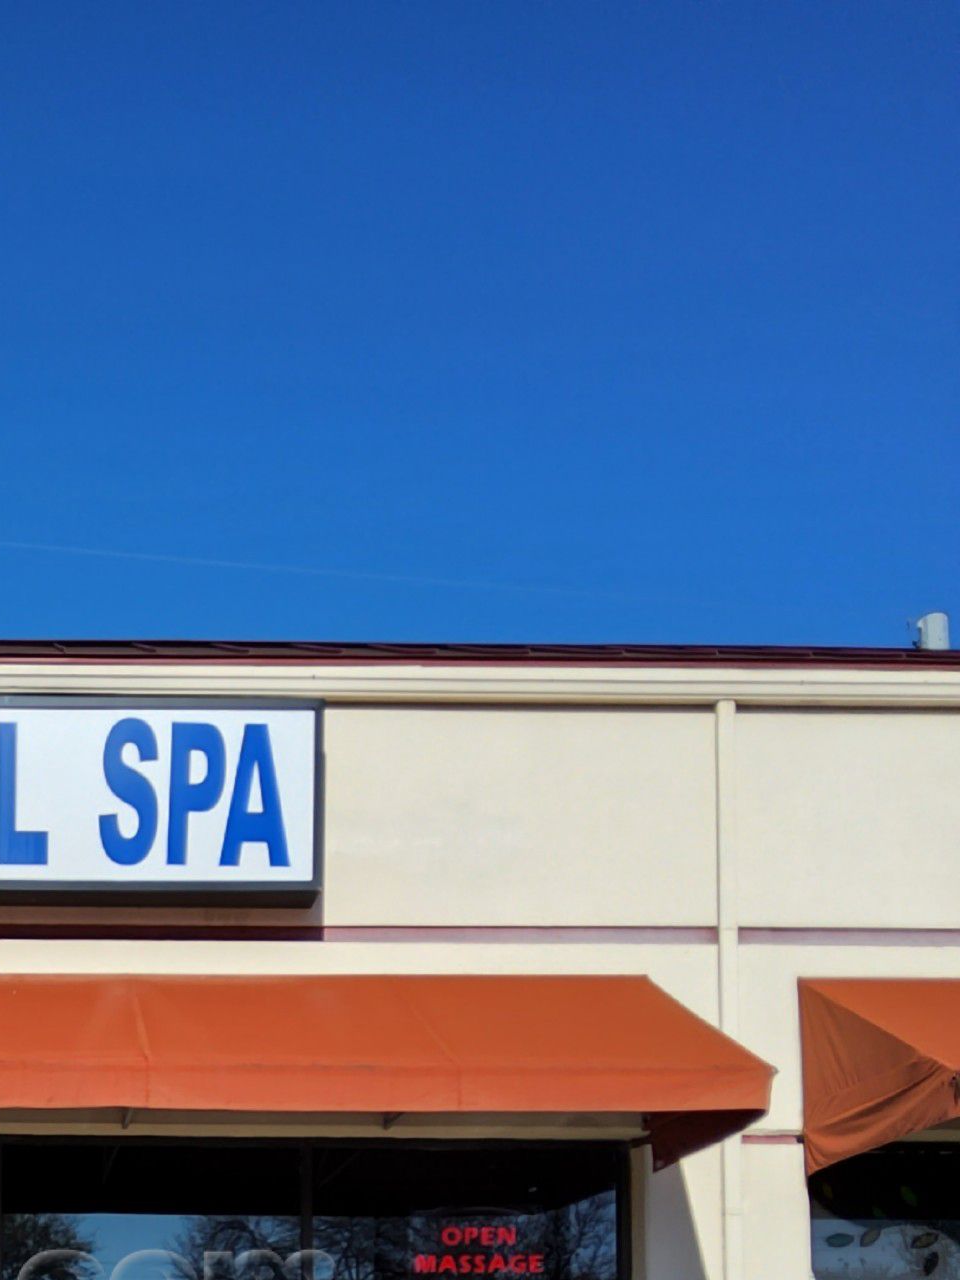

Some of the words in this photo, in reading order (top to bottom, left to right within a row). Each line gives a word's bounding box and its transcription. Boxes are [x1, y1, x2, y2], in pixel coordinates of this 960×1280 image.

[98, 716, 291, 868] SPA
[441, 1225, 517, 1247] OPEN
[414, 1253, 544, 1274] MASSAGE
